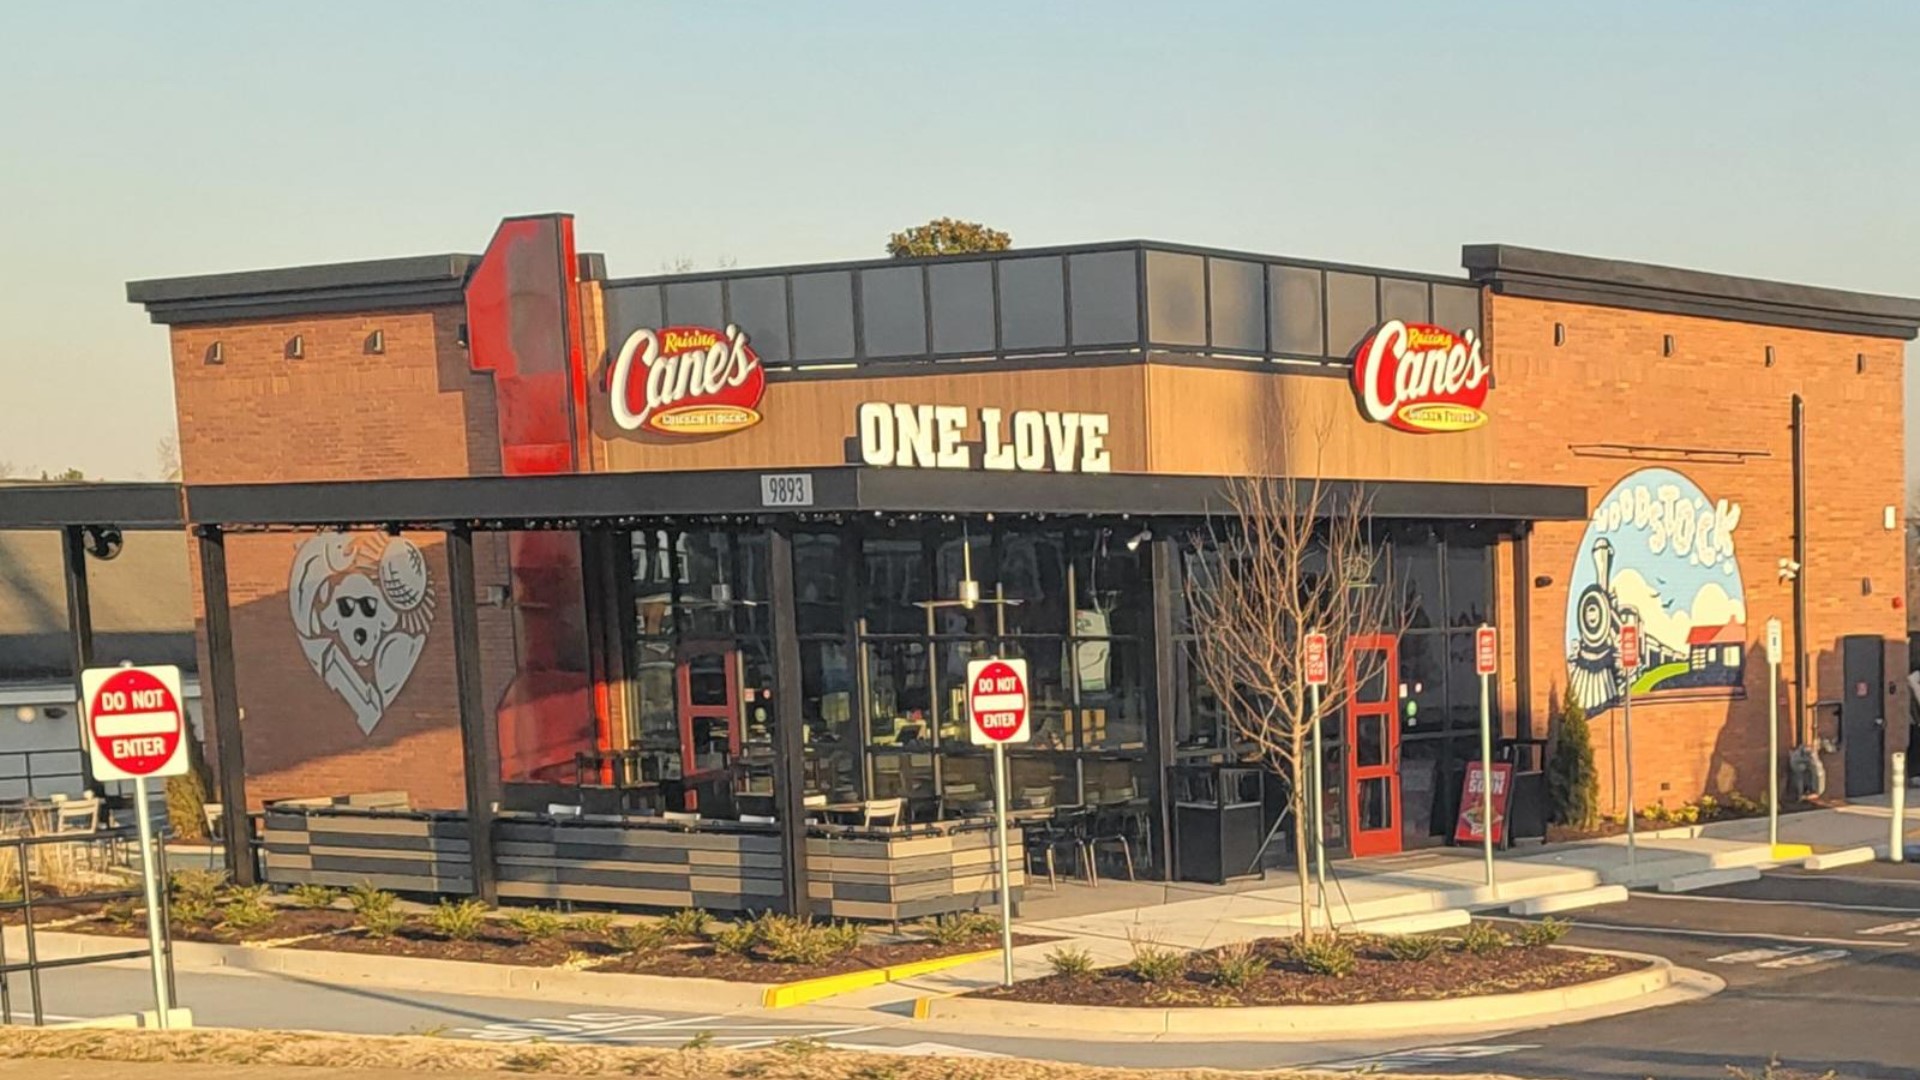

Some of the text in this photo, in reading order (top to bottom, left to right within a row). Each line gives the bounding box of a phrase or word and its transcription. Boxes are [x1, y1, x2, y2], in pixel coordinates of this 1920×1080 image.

[664, 330, 716, 353] Raising
[1407, 328, 1452, 350] Raising
[611, 324, 760, 430] Cane's
[1364, 319, 1490, 421] Cane's
[860, 402, 1112, 473] ONE LOVE
[769, 477, 804, 503] 9893
[1593, 485, 1742, 568] WOODSTOCK
[979, 676, 1016, 693] DO NOT
[101, 688, 165, 711] DO NOT
[983, 712, 1016, 728] ENTER
[112, 737, 165, 759] ENTER
